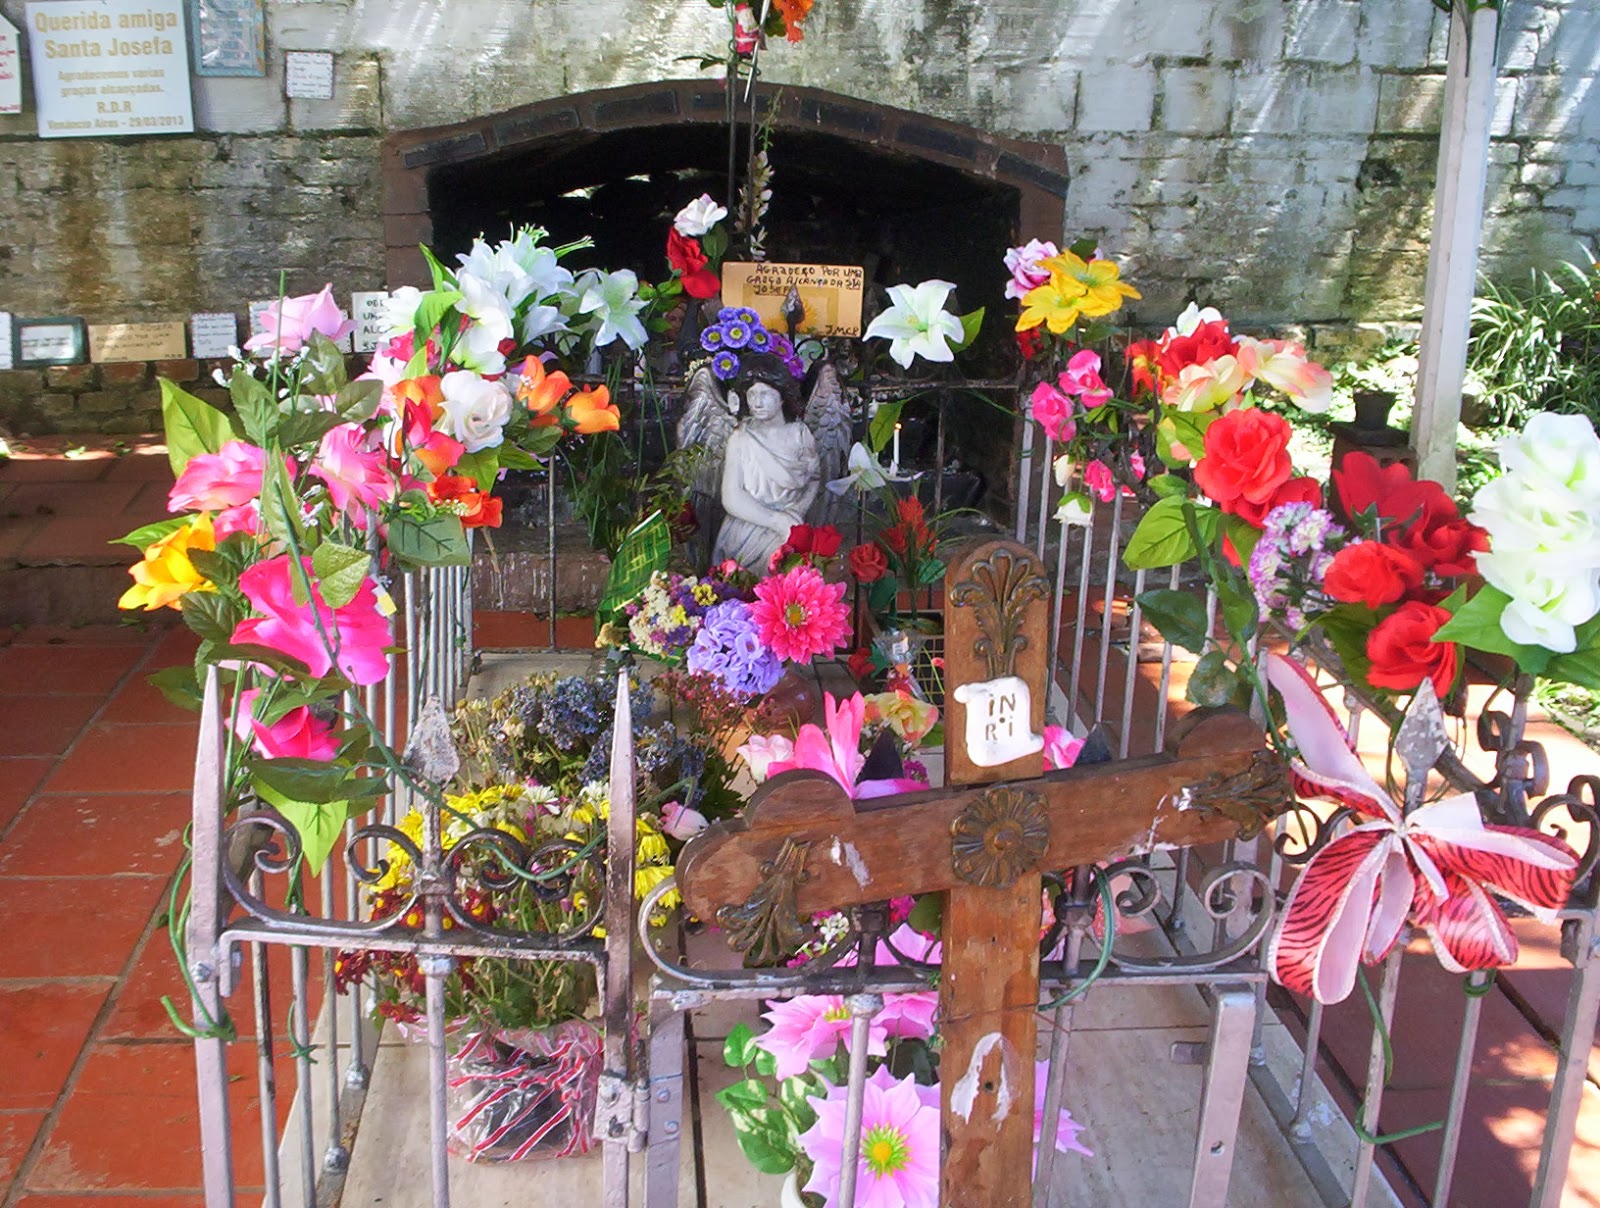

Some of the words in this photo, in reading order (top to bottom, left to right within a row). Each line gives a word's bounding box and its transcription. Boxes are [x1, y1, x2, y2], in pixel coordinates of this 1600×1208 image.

[34, 11, 111, 33] Querida
[118, 10, 178, 32] amiga
[44, 39, 101, 59] Santa
[108, 36, 173, 57] Josefa
[821, 266, 840, 277] POR
